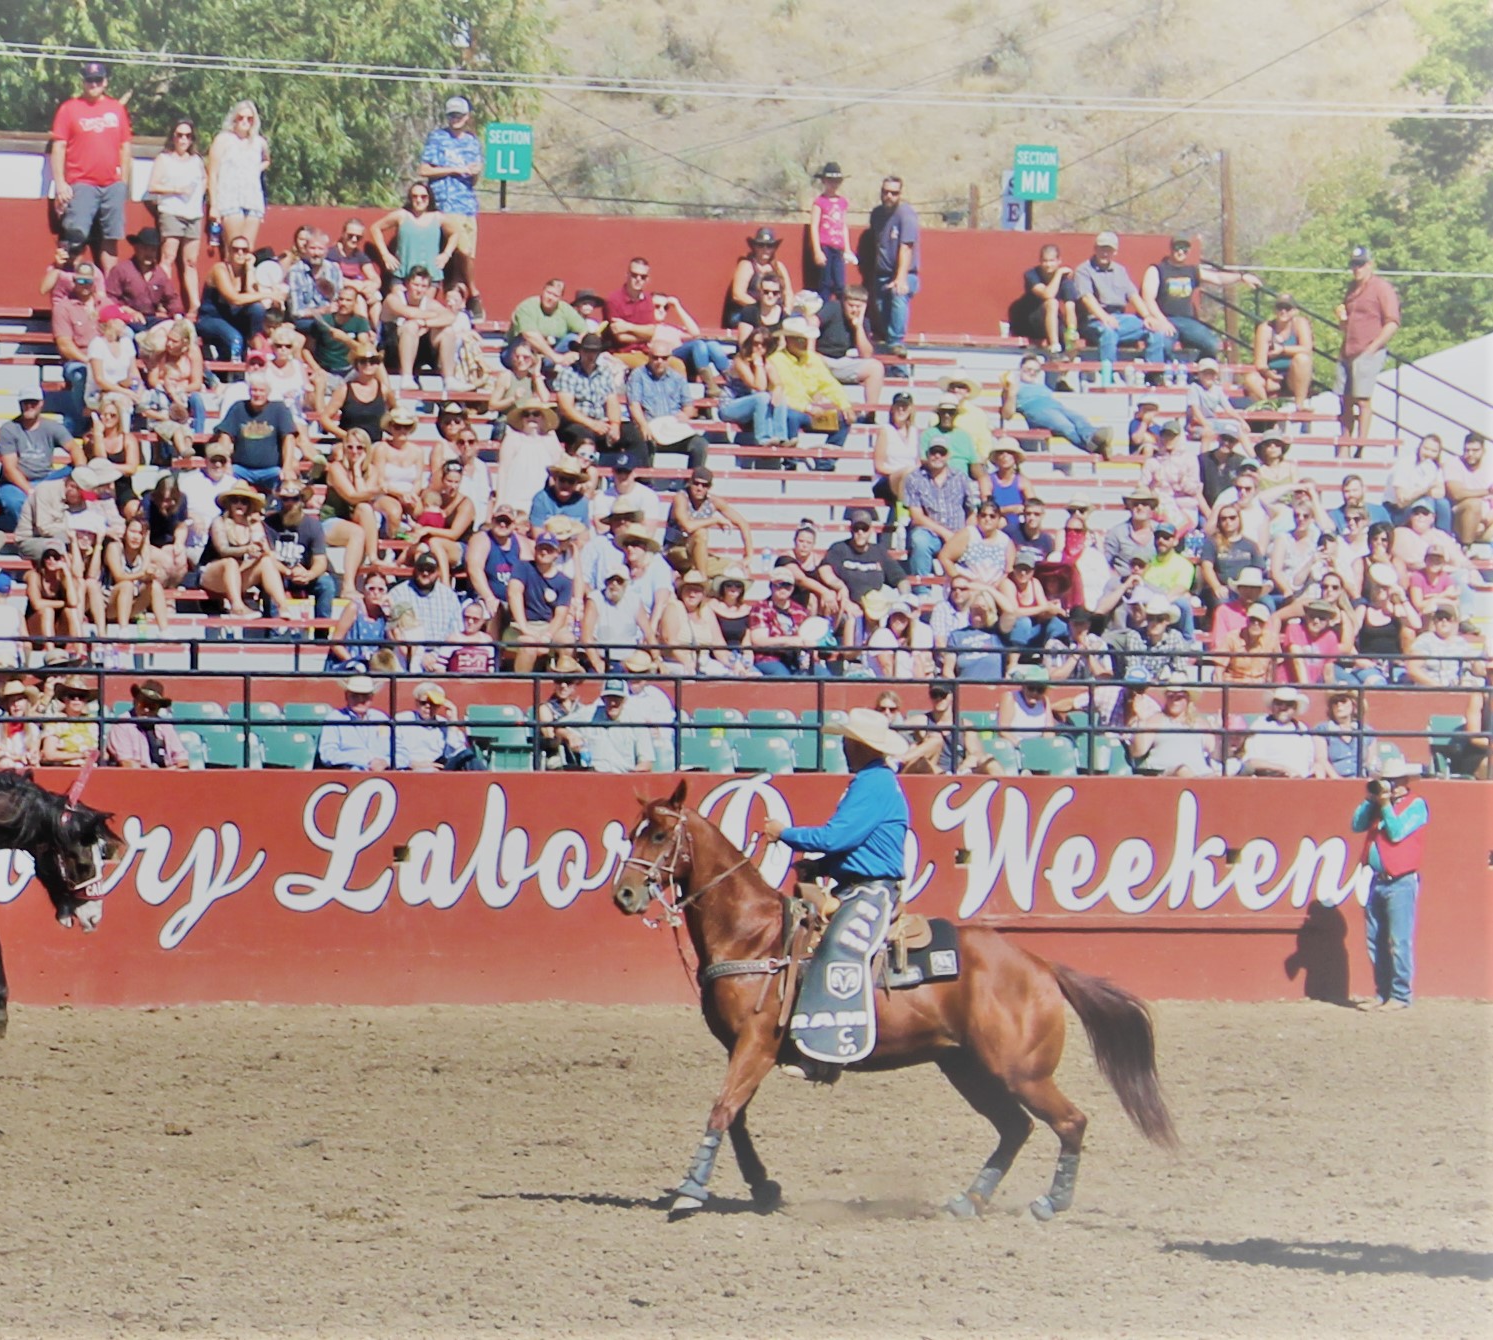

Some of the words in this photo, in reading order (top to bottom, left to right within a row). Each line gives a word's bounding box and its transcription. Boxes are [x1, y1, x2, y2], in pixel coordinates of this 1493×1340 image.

[488, 129, 531, 145] SECTION
[496, 150, 520, 174] LL
[1017, 150, 1057, 166] SECTION
[1021, 170, 1050, 193] MM
[791, 1011, 868, 1030] RAM
